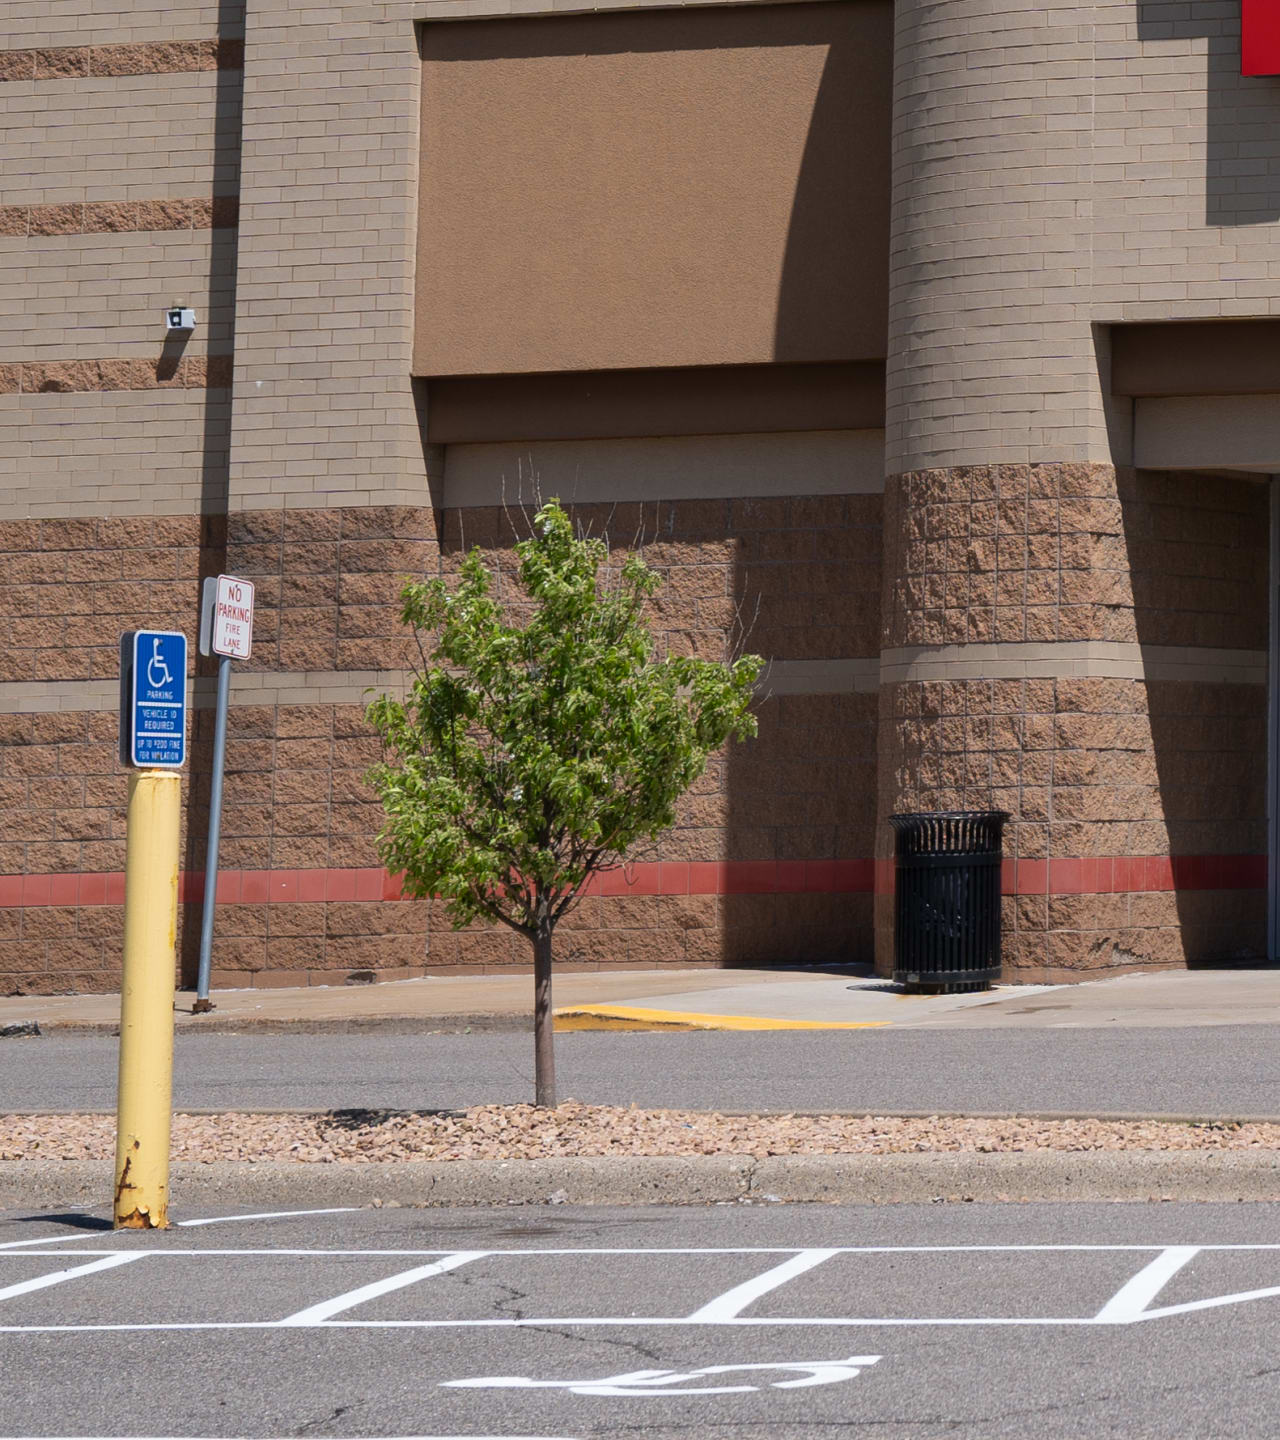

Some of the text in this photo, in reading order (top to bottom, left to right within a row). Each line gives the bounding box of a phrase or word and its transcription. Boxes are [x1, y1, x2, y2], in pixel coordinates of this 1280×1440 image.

[228, 586, 241, 602] NO
[217, 602, 250, 623] PARKING
[225, 622, 241, 635] FIRE
[224, 637, 240, 649] LANE
[147, 690, 174, 700] PARKING
[142, 709, 177, 719] VEHICLE ID
[144, 720, 175, 730] REQUIRED
[137, 739, 145, 748] UP
[146, 739, 153, 749] TO
[169, 740, 181, 750] FINE
[139, 751, 150, 760] FOR
